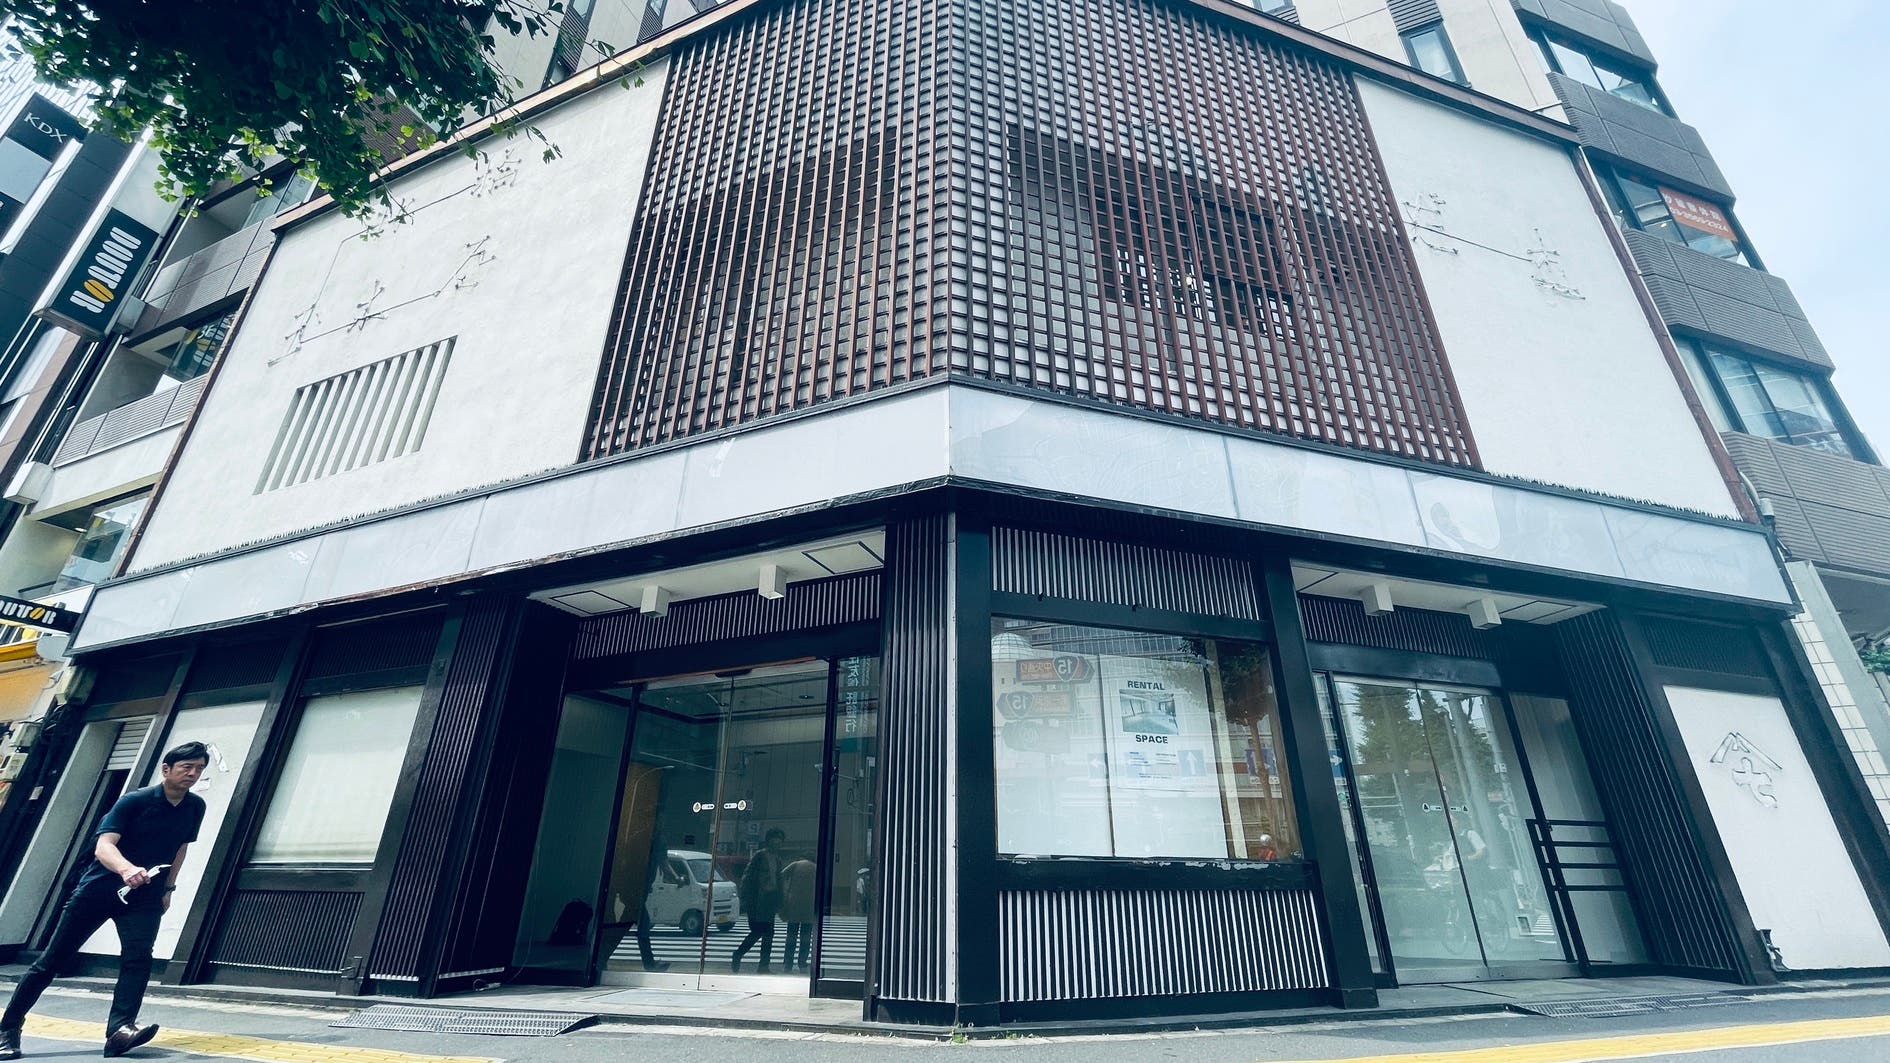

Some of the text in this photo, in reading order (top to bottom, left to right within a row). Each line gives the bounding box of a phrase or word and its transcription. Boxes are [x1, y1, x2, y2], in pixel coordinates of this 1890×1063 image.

[23, 112, 68, 143] KDX
[69, 226, 142, 314] DOUTOR
[1127, 680, 1166, 691] RENTAL
[1135, 734, 1169, 744] SPACE
